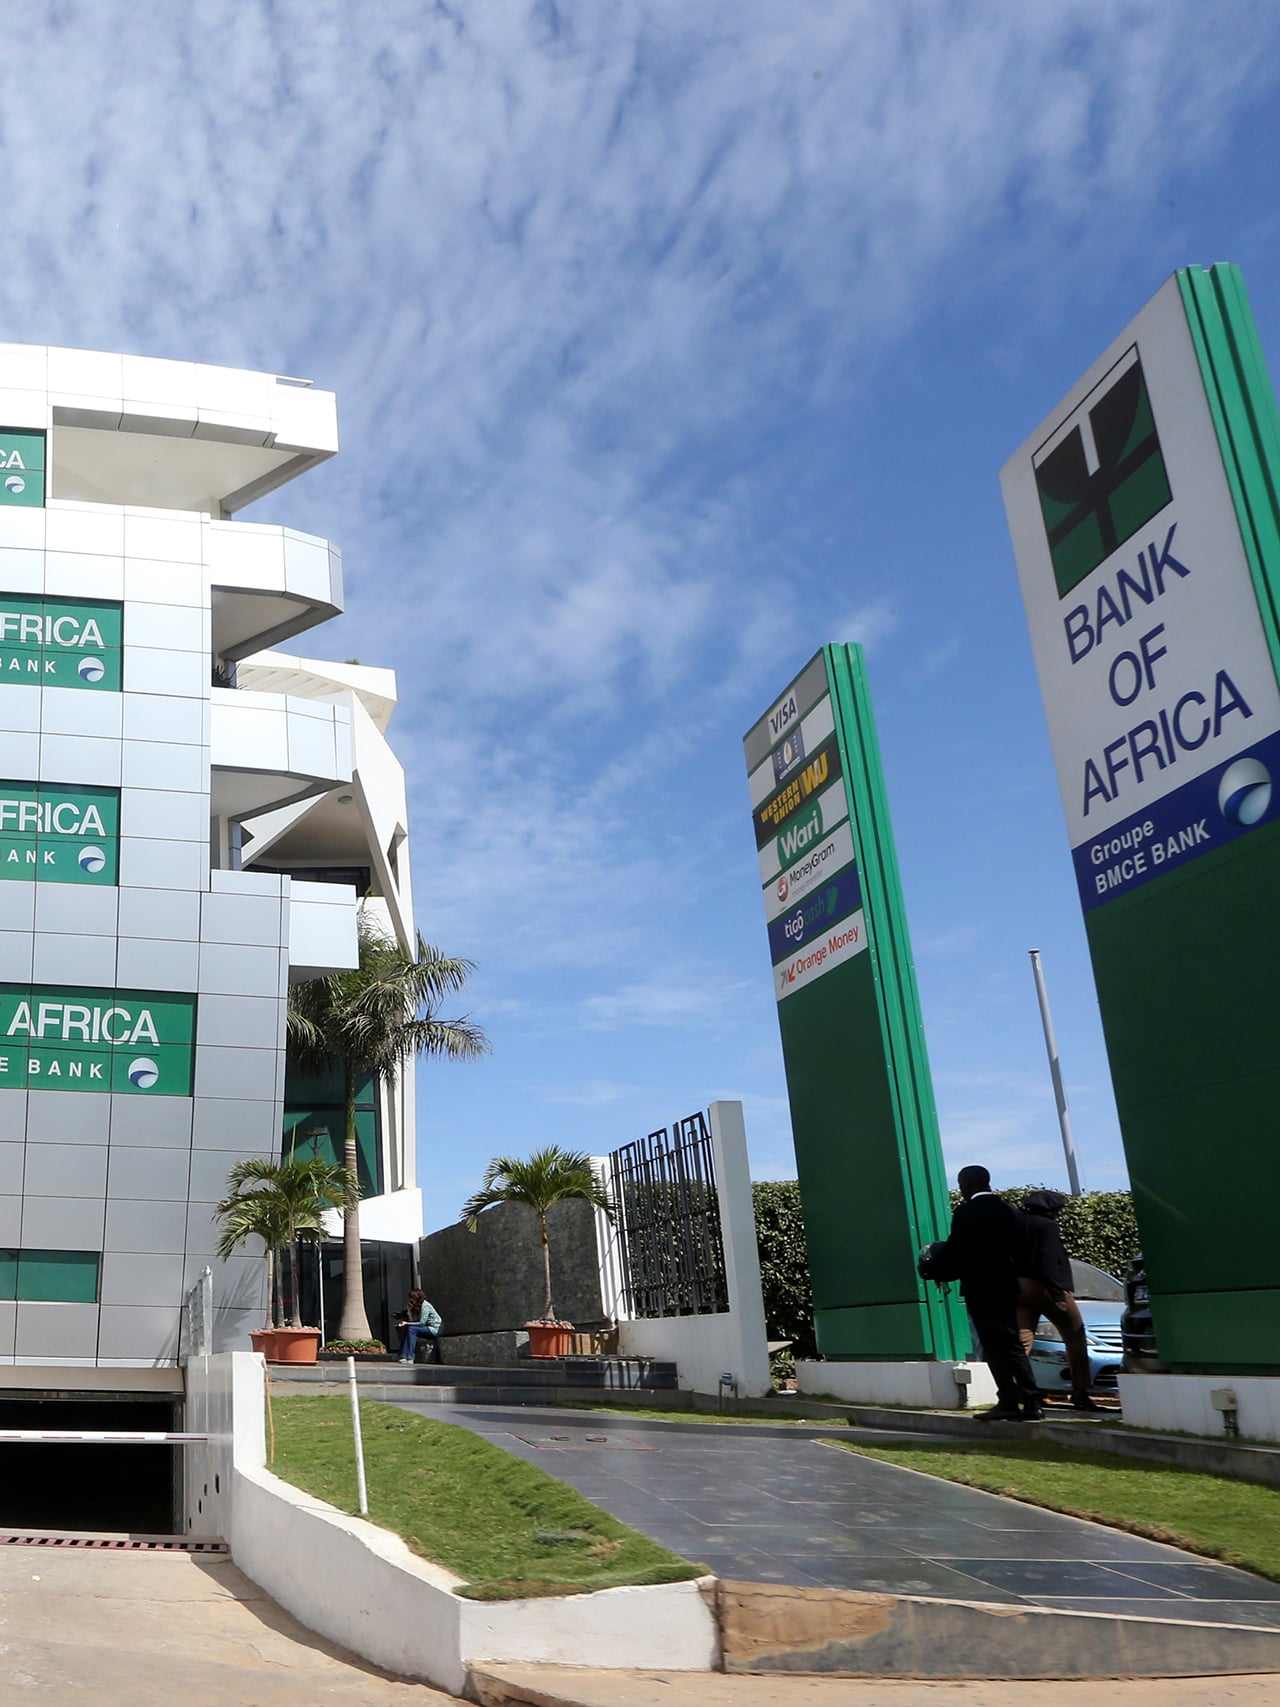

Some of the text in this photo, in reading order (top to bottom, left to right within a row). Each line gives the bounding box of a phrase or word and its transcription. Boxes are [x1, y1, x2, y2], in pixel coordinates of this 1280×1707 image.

[1063, 521, 1191, 665] BANK
[1109, 622, 1168, 707] OF
[770, 697, 797, 734] VISA
[1083, 669, 1253, 817] AFRICA
[761, 779, 799, 823] WESTERN
[773, 791, 800, 824] UNION
[780, 810, 820, 860] Wari
[1090, 820, 1154, 865] Groupe
[1095, 818, 1211, 894] BMCE BANK
[789, 843, 835, 885] MoneyGram
[796, 926, 859, 975] Orange Money
[6, 1001, 160, 1047] AFRICA
[28, 1058, 103, 1079] BANK
